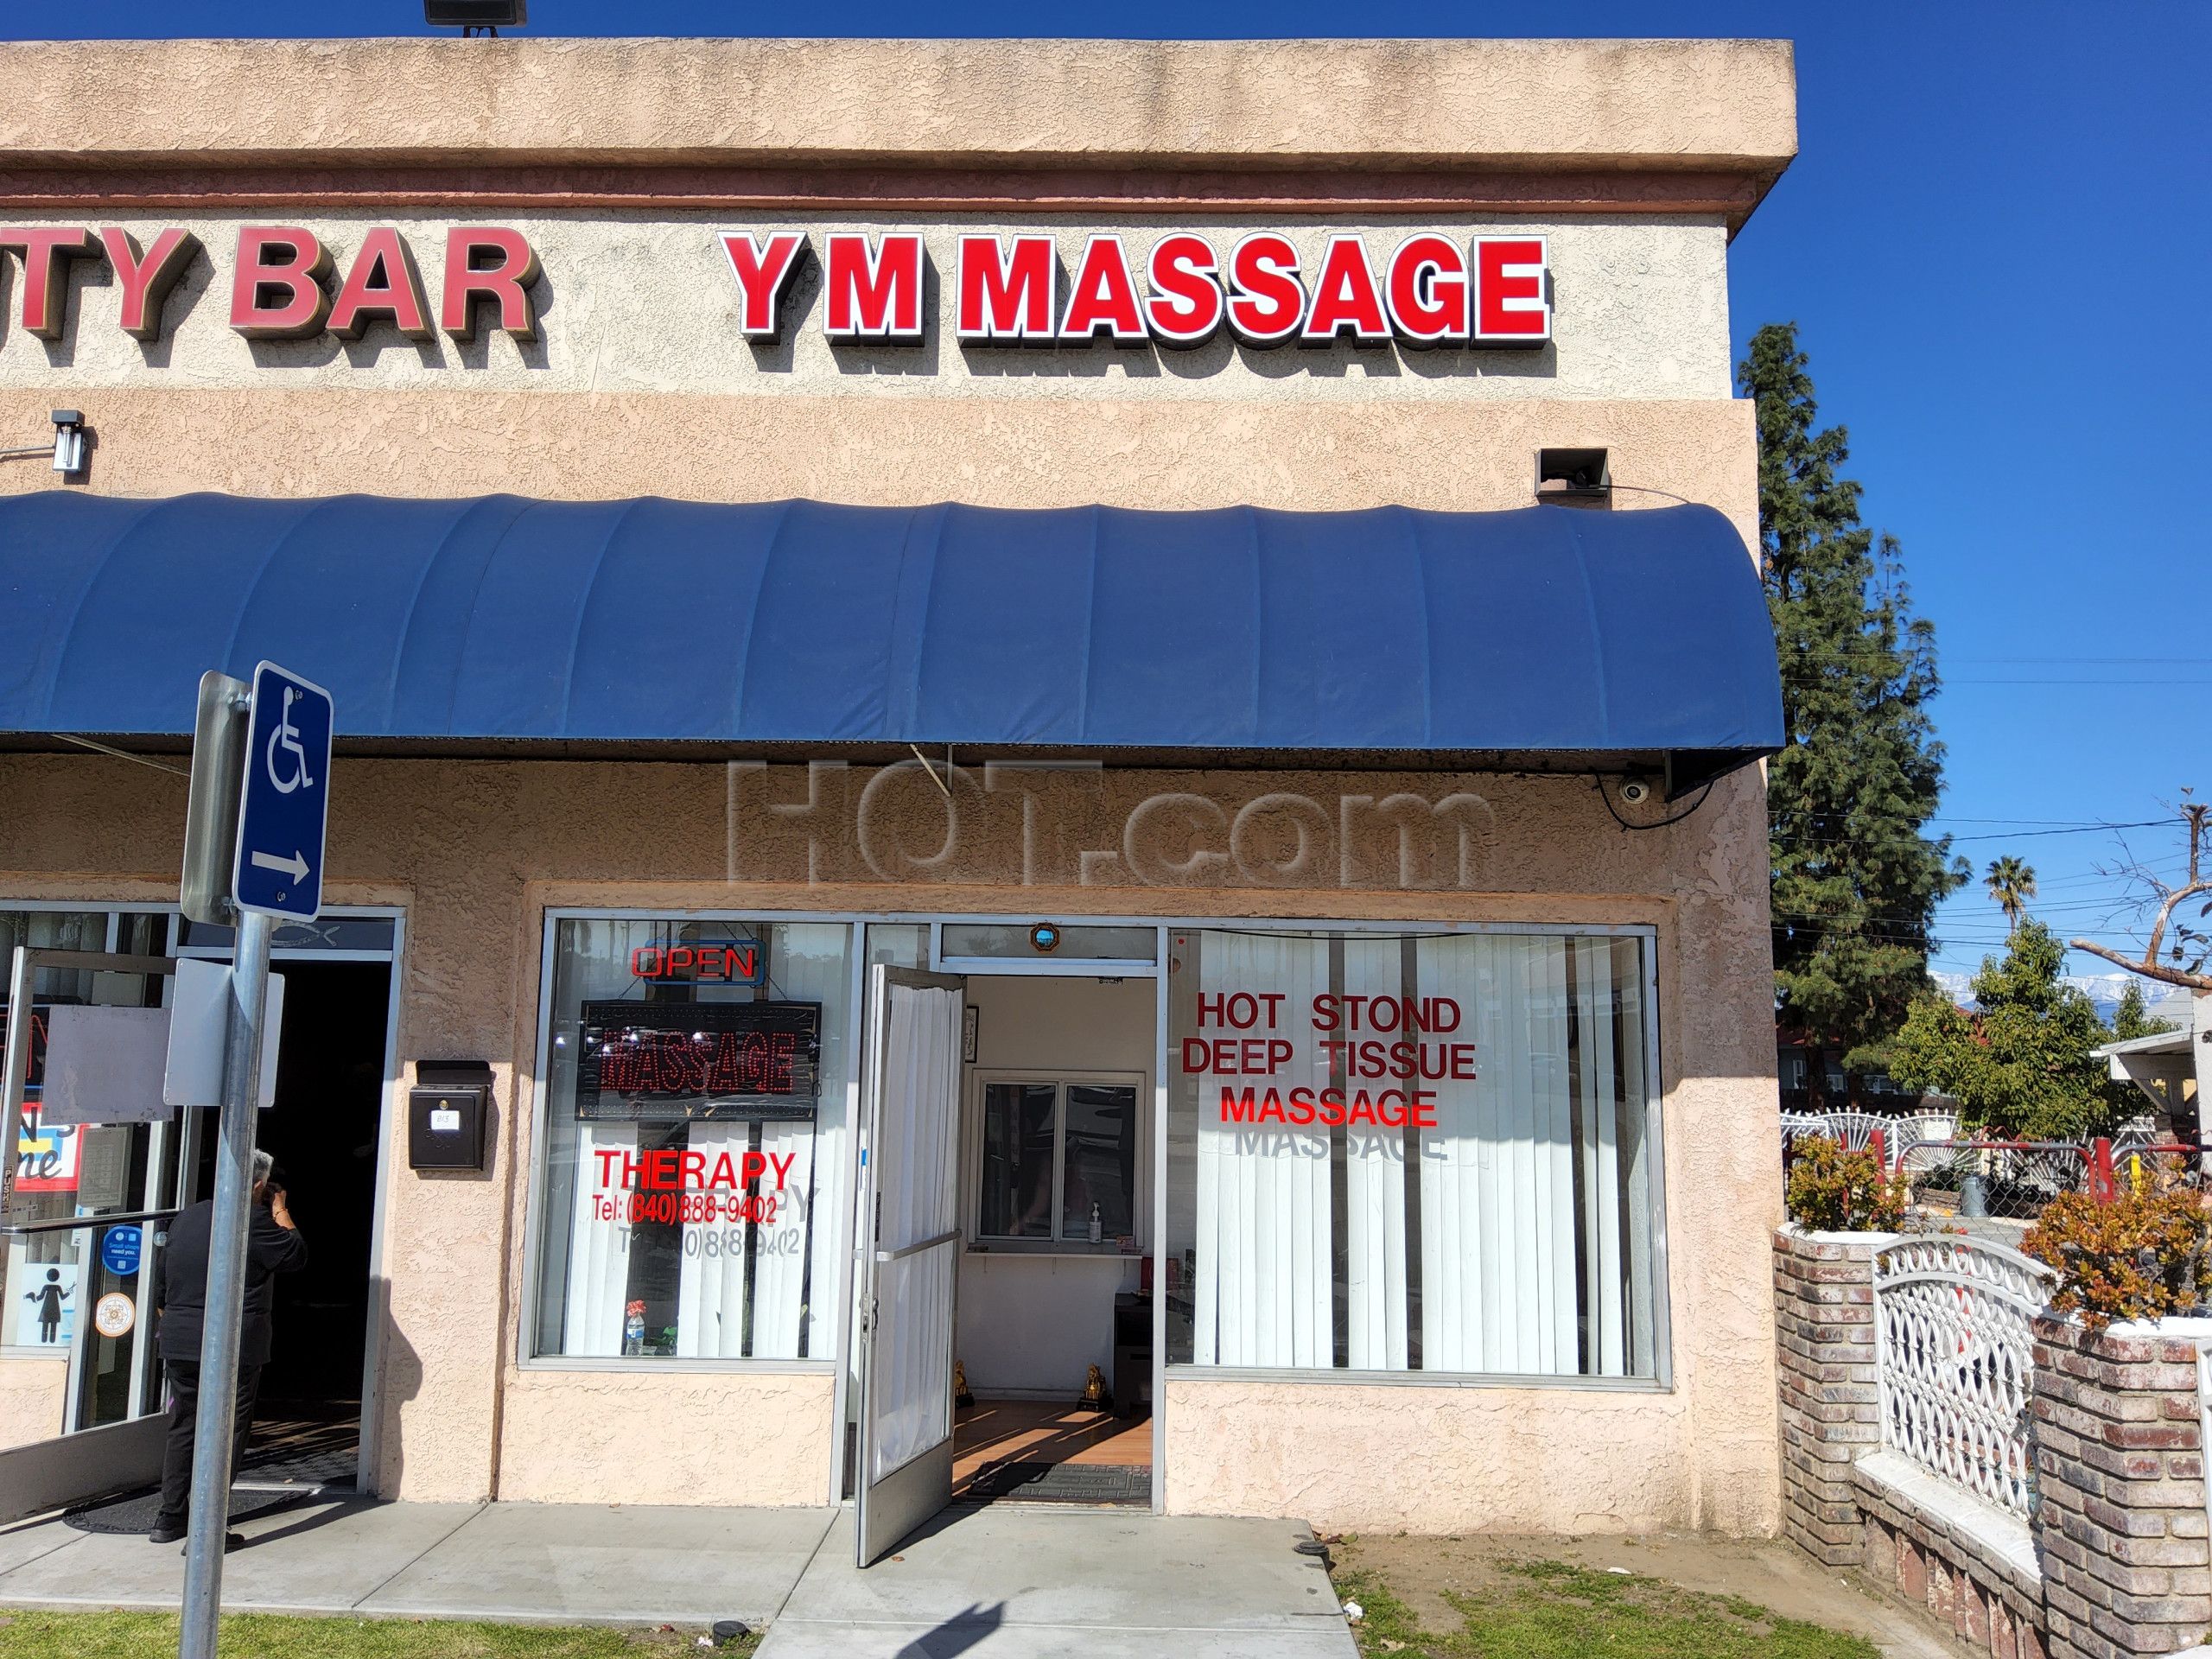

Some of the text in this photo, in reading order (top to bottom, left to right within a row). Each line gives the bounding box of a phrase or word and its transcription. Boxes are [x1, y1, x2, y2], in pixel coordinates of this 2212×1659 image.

[229, 226, 533, 332] BAR
[957, 230, 1552, 342] MASSAGE
[631, 947, 755, 978] OPEN
[1196, 992, 1461, 1033] HOT STOND
[601, 1030, 796, 1092] MASSAGE
[1181, 1037, 1477, 1081] DEEP TISSUE
[1219, 1085, 1439, 1128] MASSAGE
[594, 1149, 797, 1191] THERAPY
[592, 1194, 622, 1223] Tel:
